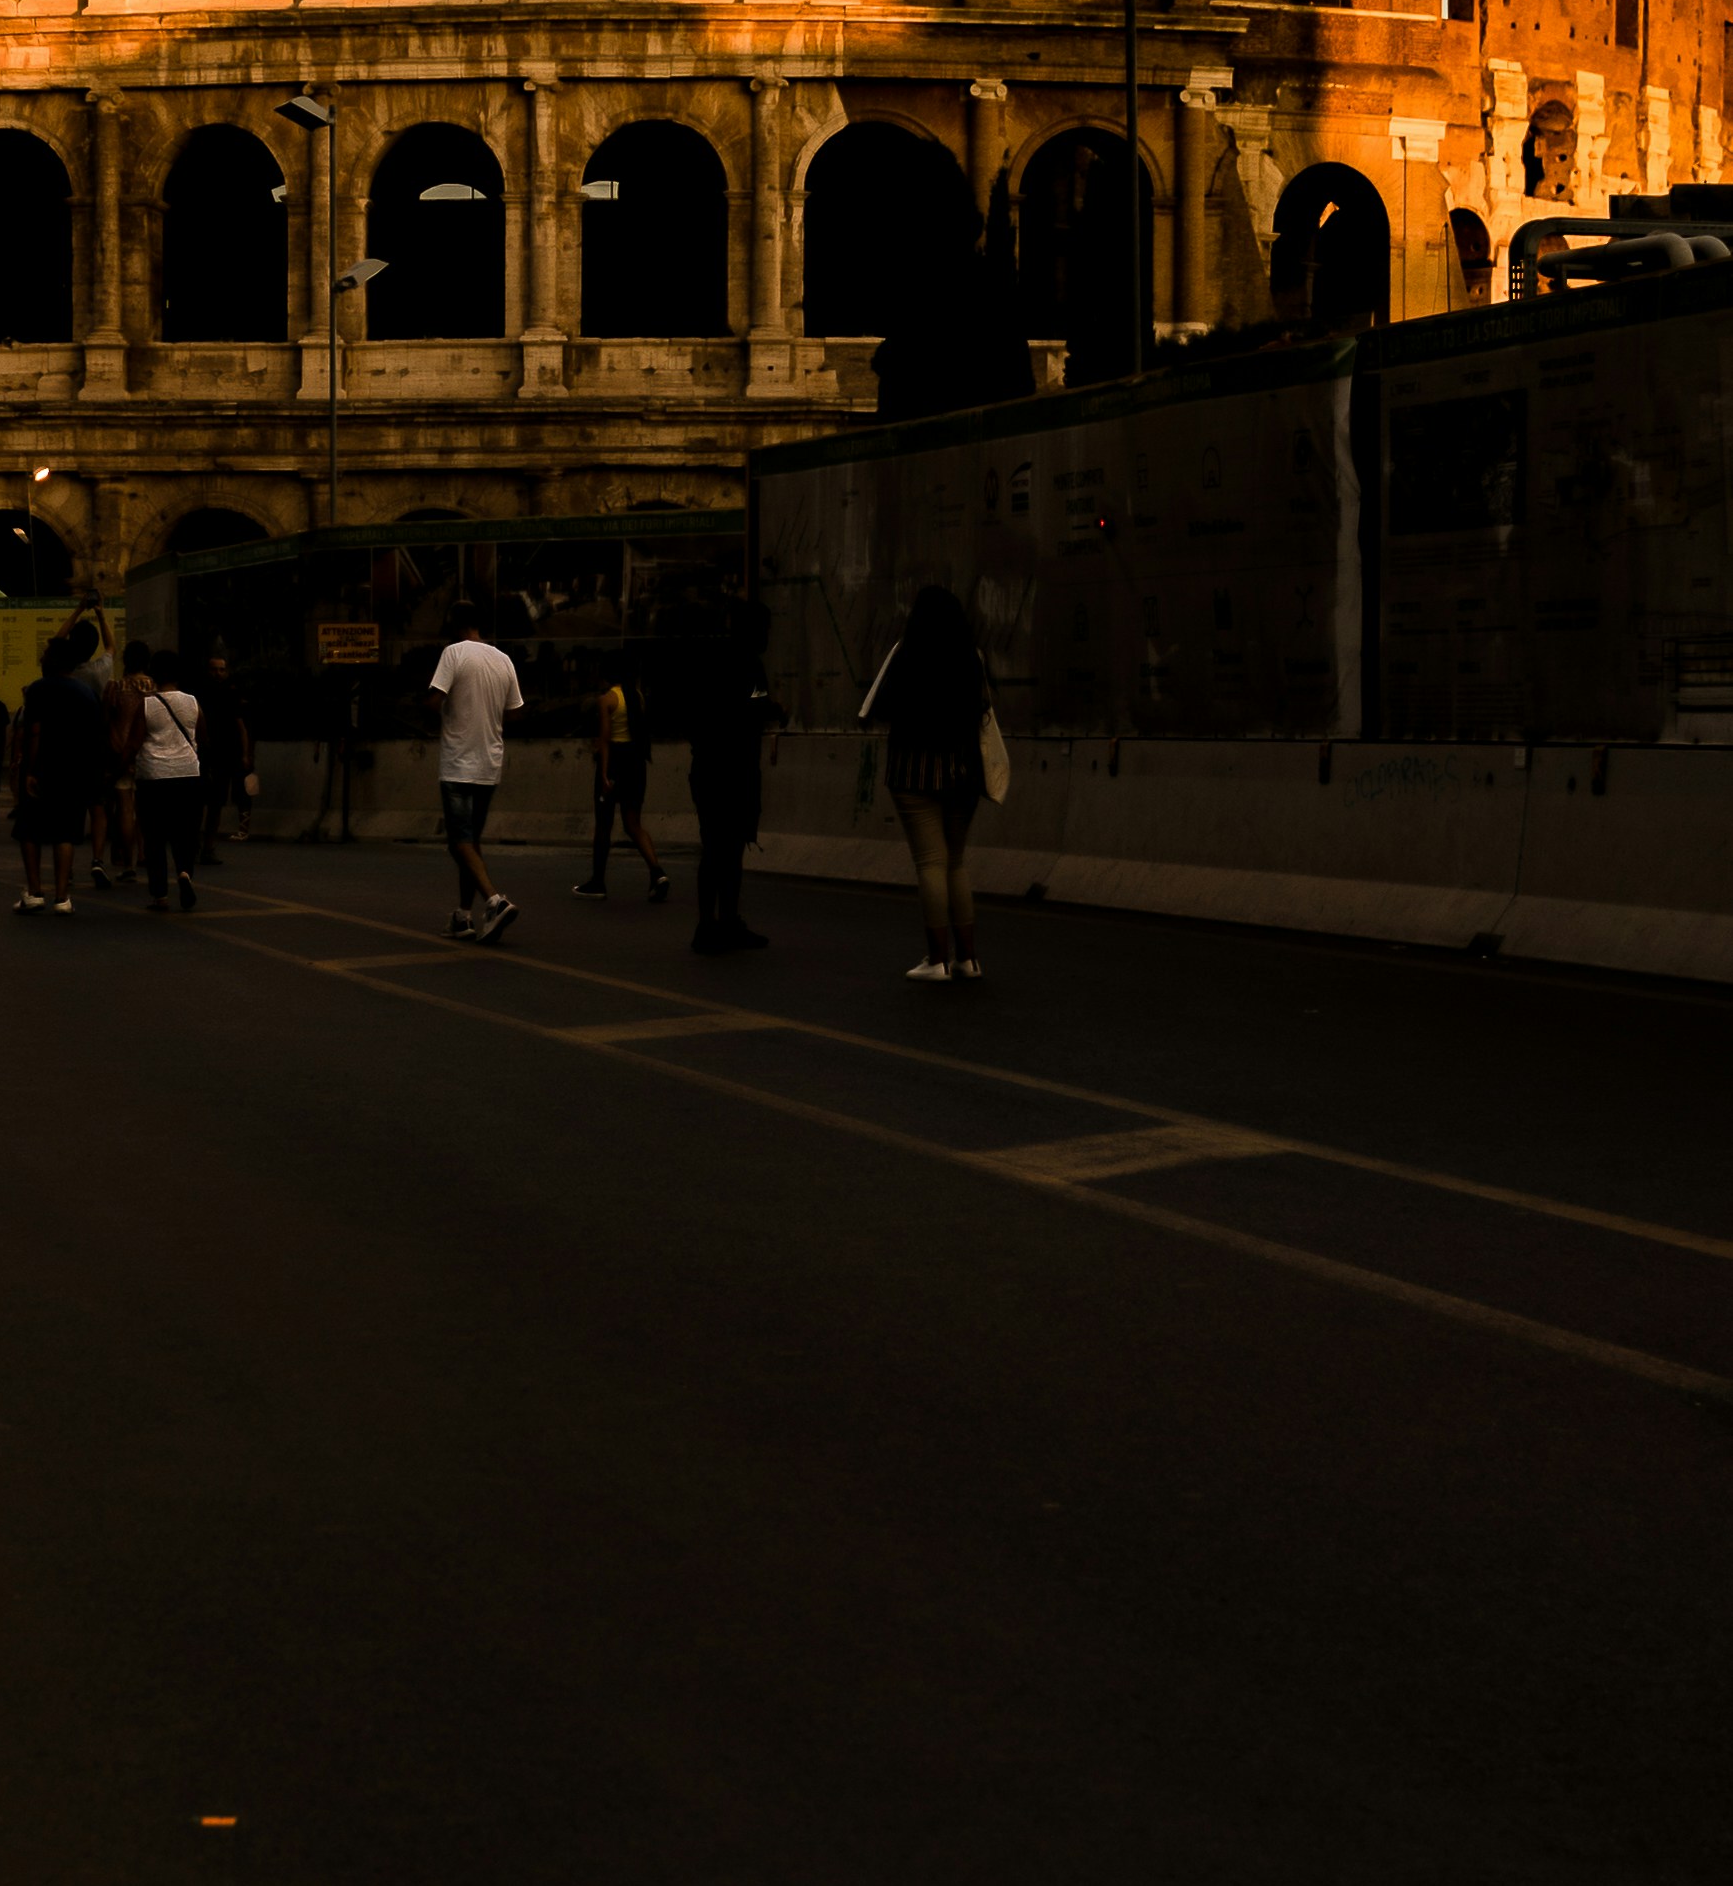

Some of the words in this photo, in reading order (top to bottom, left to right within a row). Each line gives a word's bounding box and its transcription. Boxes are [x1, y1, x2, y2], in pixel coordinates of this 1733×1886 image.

[1467, 321, 1481, 345] LA
[1483, 312, 1536, 343] STAZIONE
[1539, 307, 1565, 332] FORI
[1568, 296, 1627, 325] IMPERIALI
[603, 520, 617, 532] VIA
[621, 519, 637, 531] DEI
[640, 518, 664, 531] FORI
[665, 515, 715, 530] IMPERIALI
[322, 627, 375, 636] ATTENZIONE
